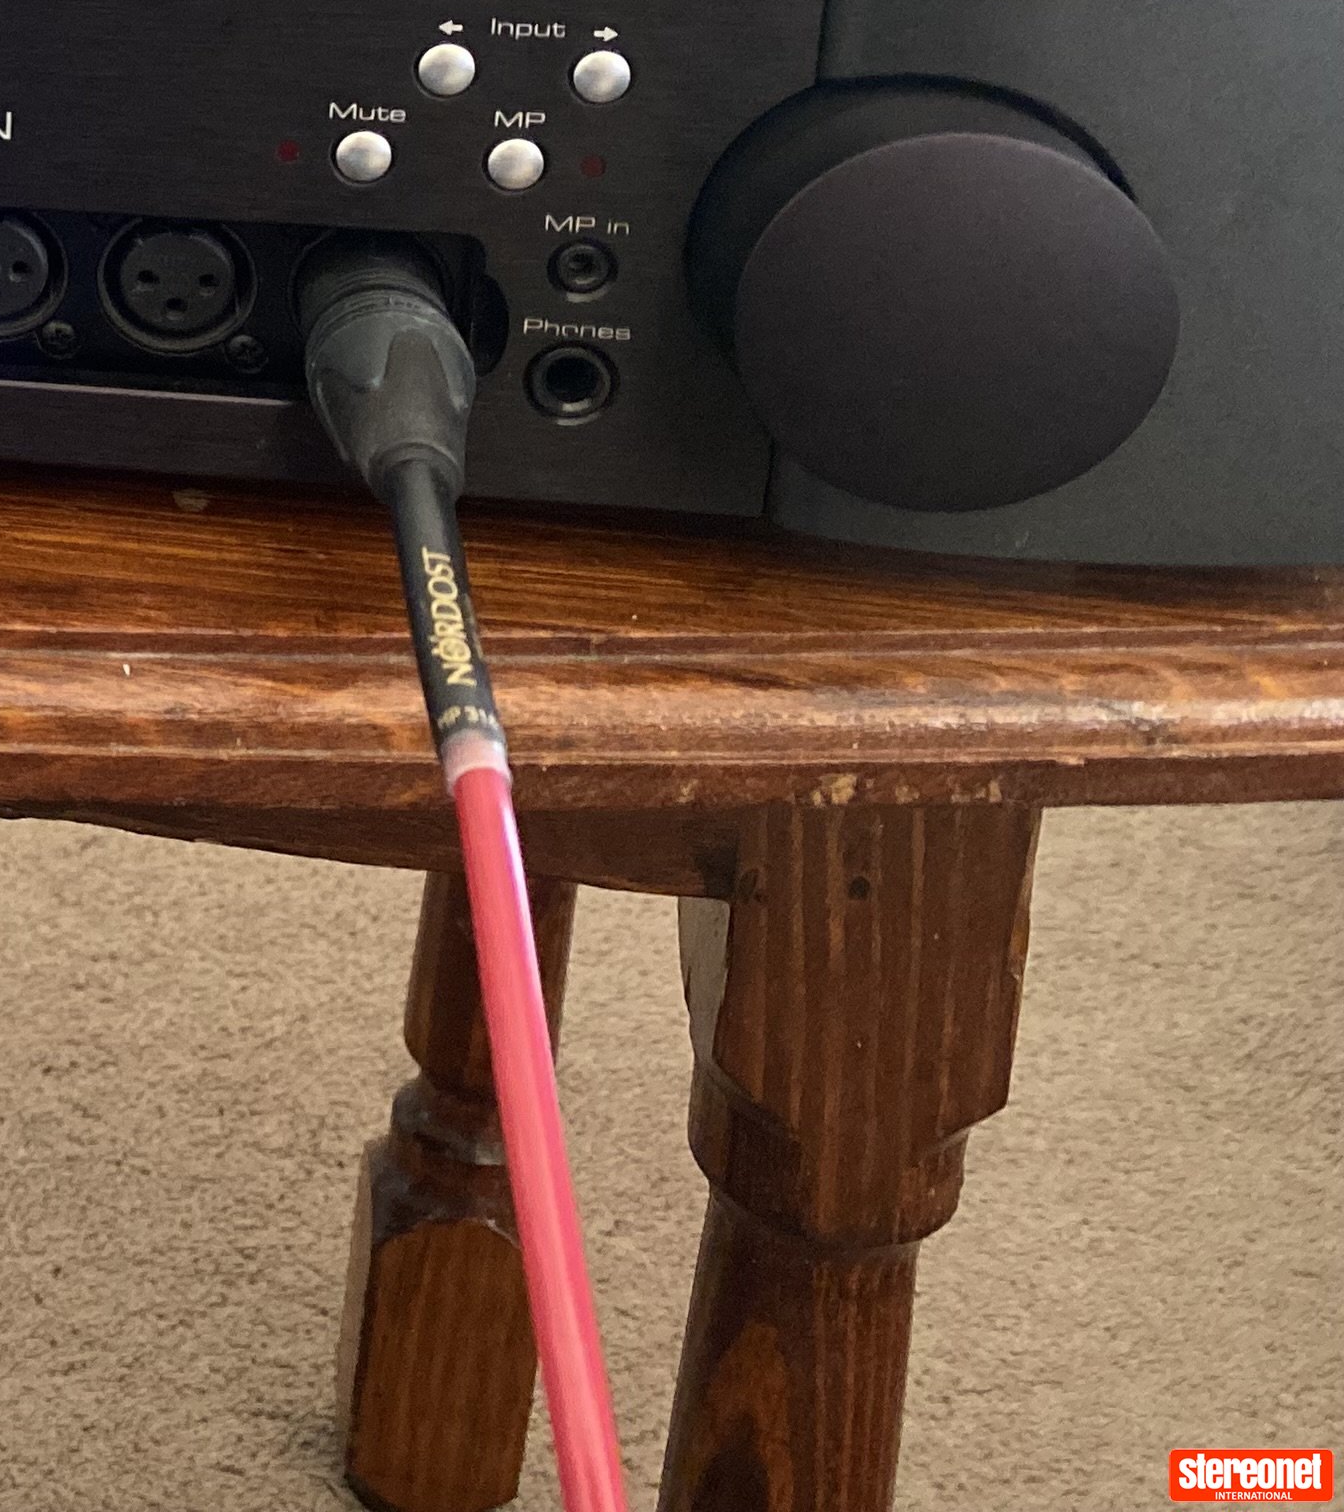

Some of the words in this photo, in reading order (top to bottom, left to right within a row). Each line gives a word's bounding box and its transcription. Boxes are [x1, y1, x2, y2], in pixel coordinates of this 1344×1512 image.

[490, 18, 567, 40] Input
[328, 102, 406, 123] Mute
[494, 110, 546, 129] MP
[544, 214, 596, 234] MP
[607, 219, 630, 236] in
[523, 317, 631, 341] Phones
[422, 545, 477, 687] NORDOST
